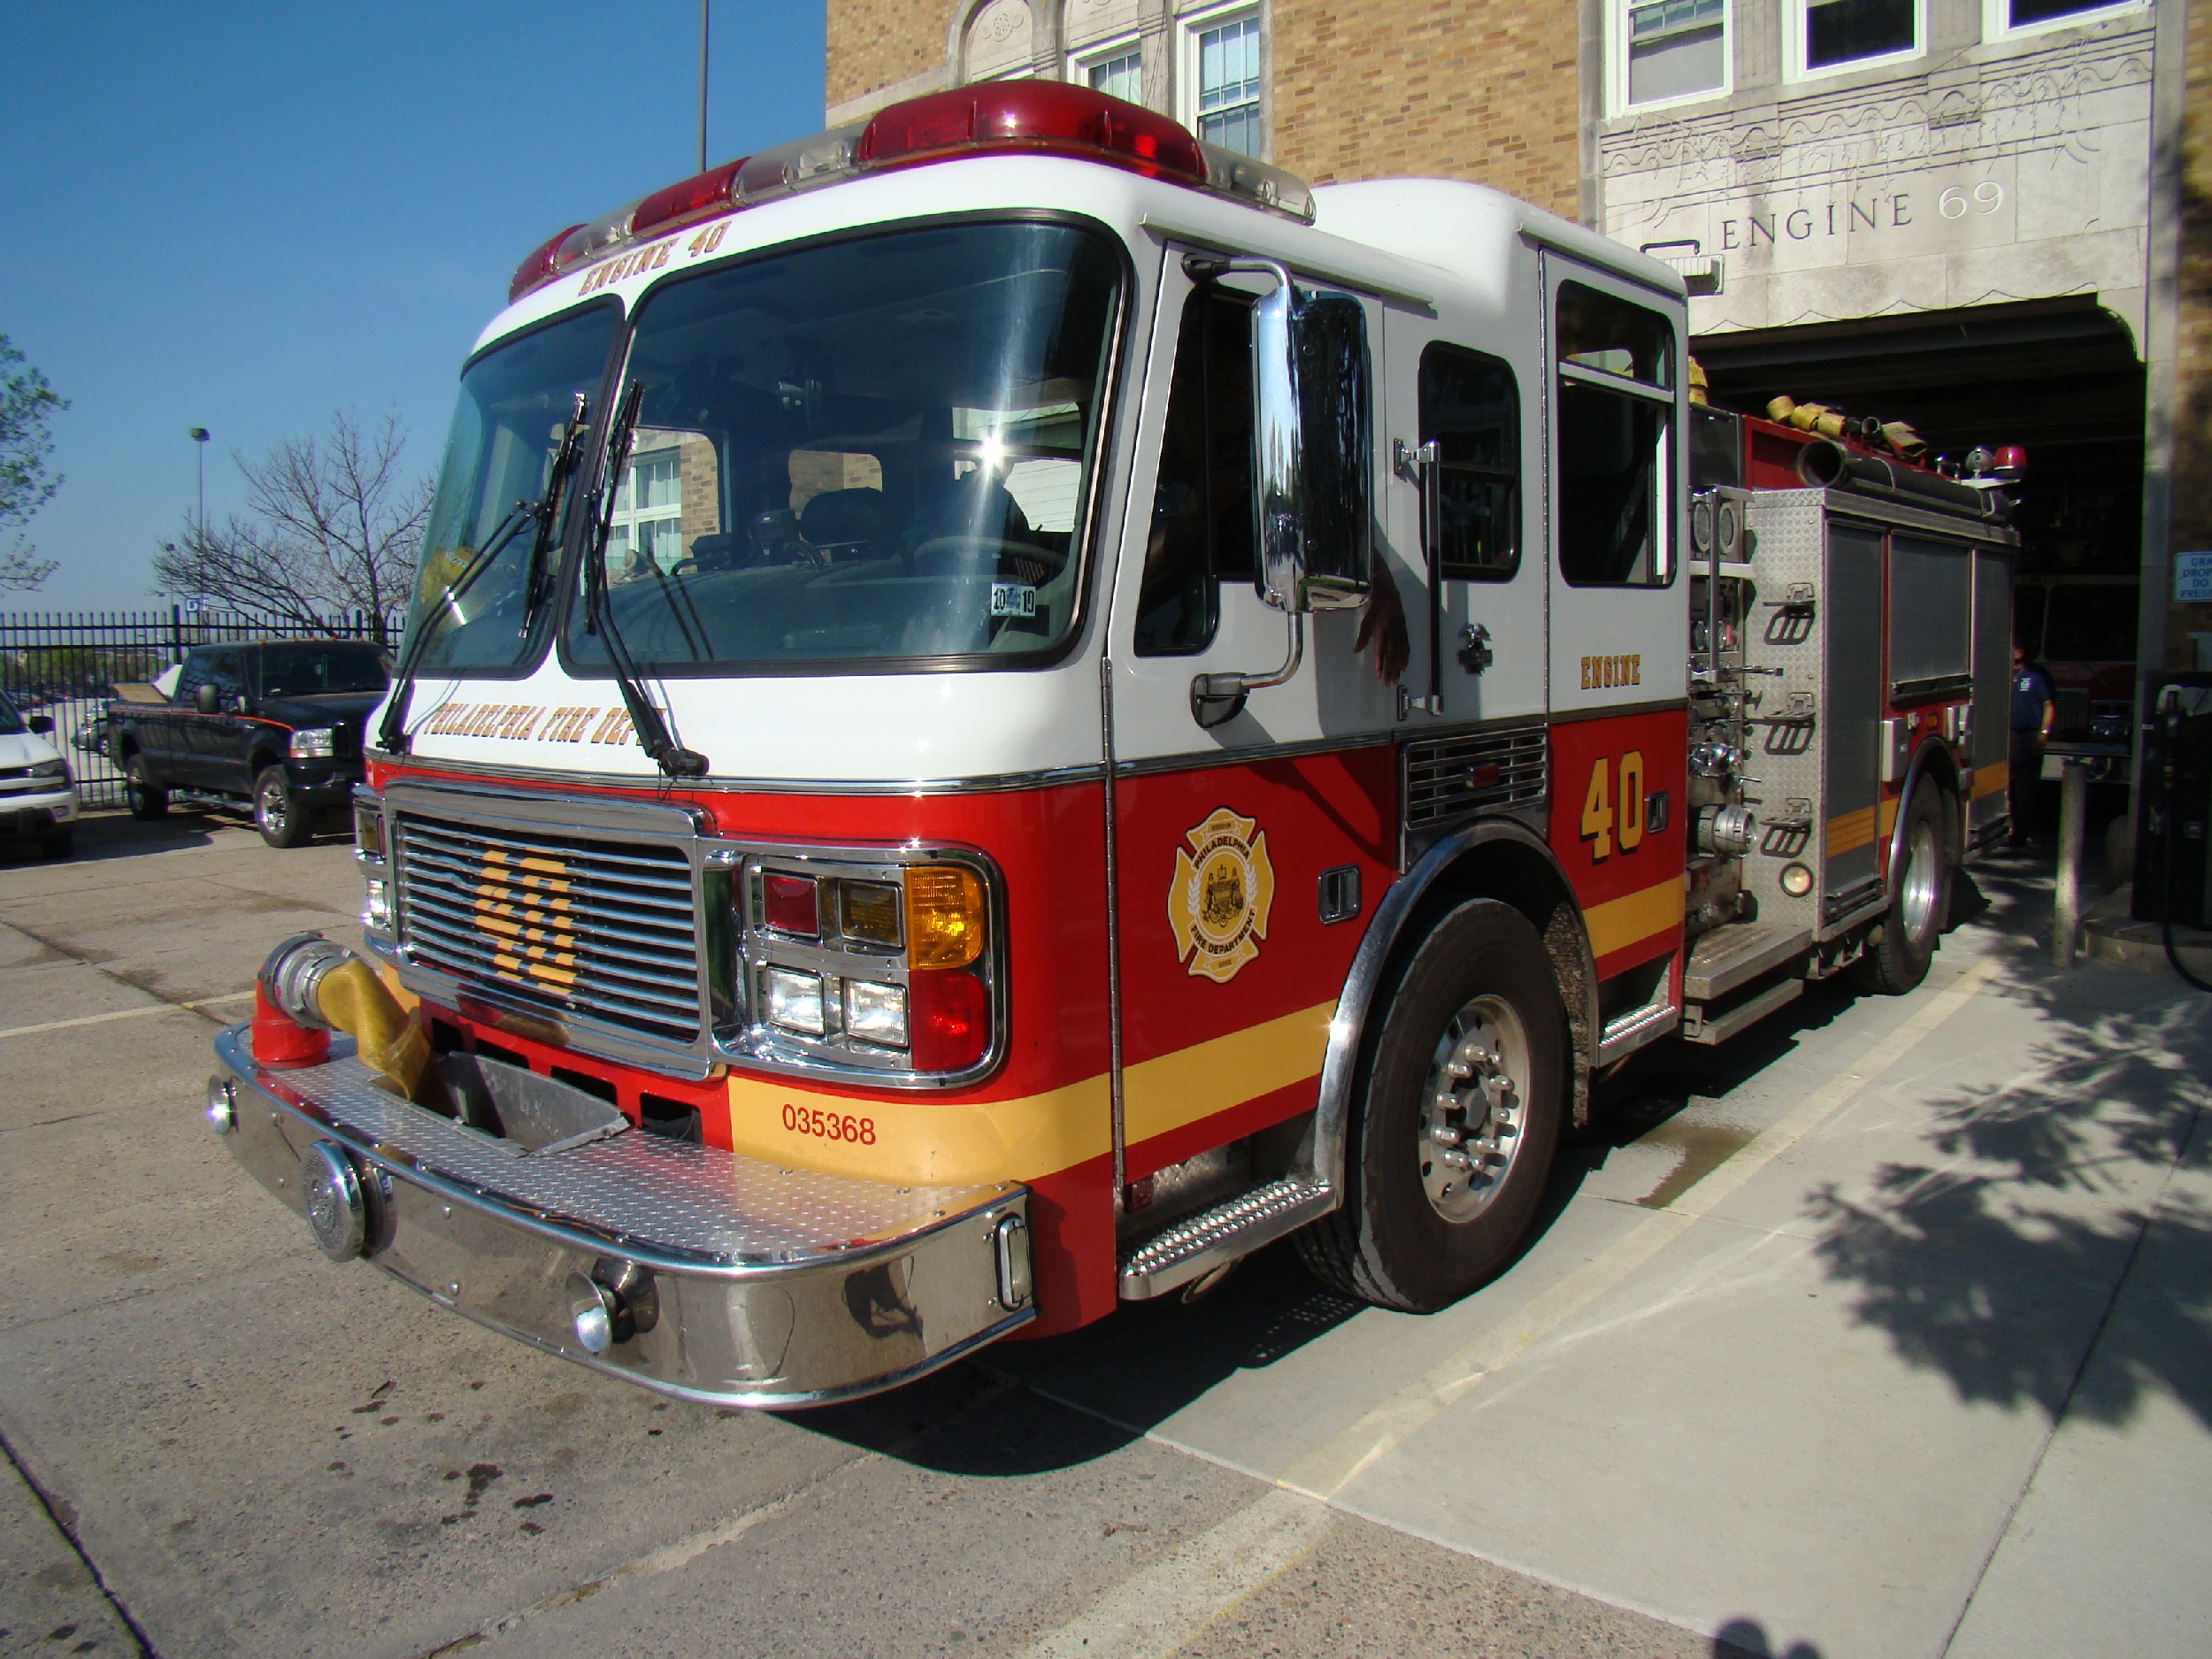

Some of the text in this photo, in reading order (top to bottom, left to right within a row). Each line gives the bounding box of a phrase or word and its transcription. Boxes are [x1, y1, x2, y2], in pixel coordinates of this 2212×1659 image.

[1720, 180, 2003, 250] ENGINE 69
[578, 221, 732, 296] ENGINE 40
[1580, 655, 1640, 690] ENGINE
[424, 703, 547, 741] PHILADELPHIA
[537, 707, 602, 743] FIRE
[1580, 749, 1644, 865] 40
[1194, 836, 1250, 870] PHILADELPHIA
[1191, 909, 1256, 955] FIRE DEPARTMENT
[782, 1103, 877, 1146] 035368
